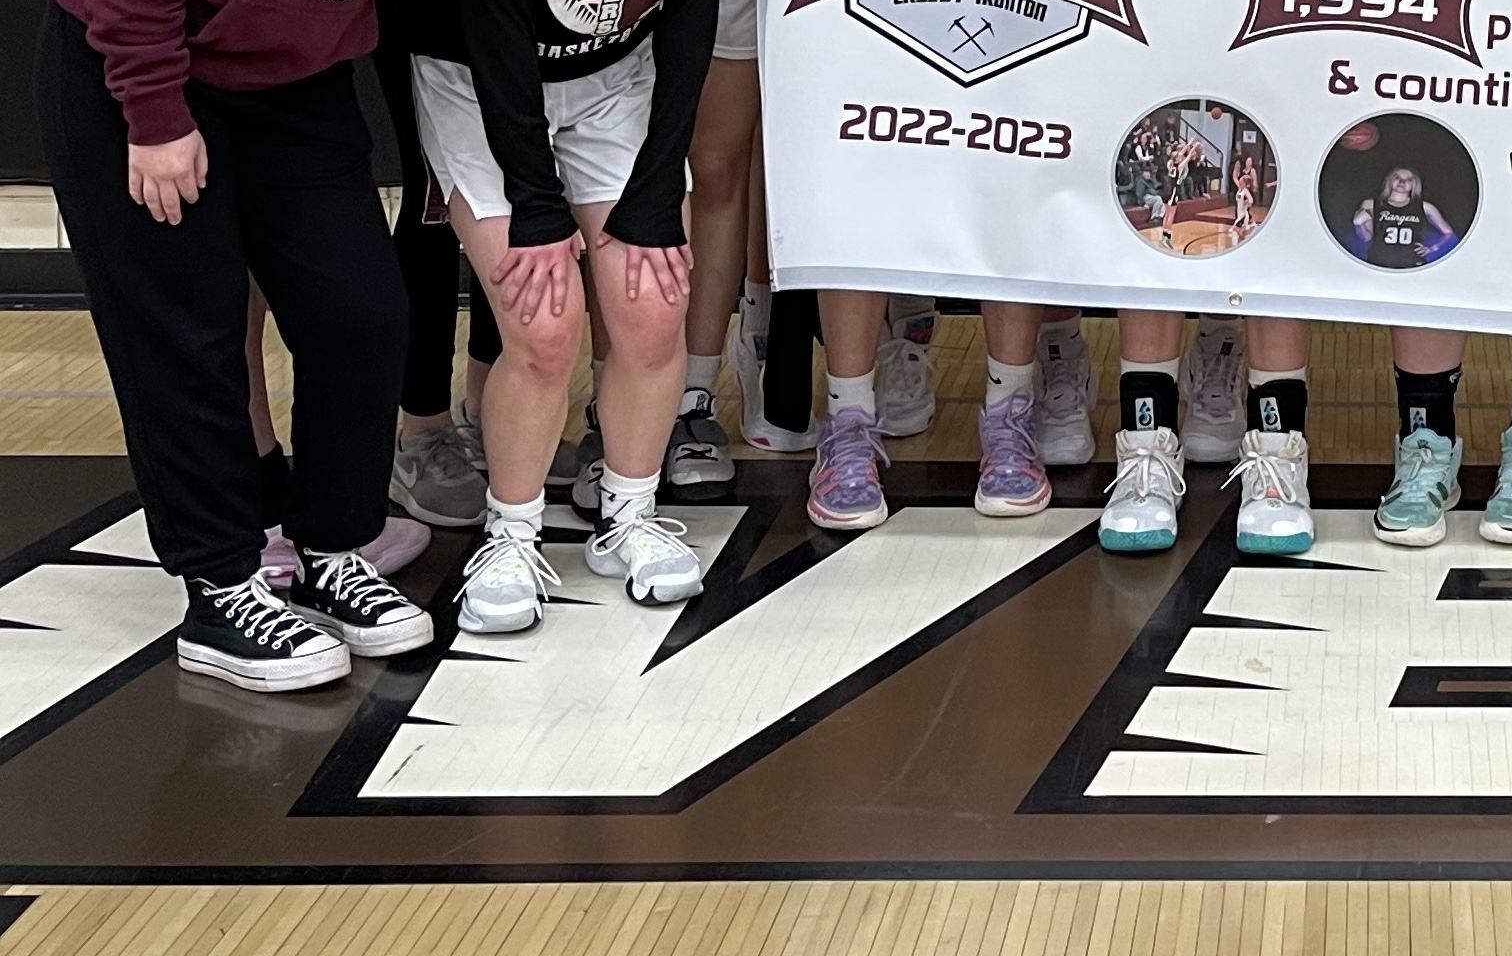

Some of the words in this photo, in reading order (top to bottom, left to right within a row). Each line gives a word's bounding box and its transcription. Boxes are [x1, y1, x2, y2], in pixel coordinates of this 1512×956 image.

[1327, 61, 1360, 96] &
[839, 104, 1072, 159] 2022-2023
[1378, 210, 1420, 226] Rangers
[1384, 226, 1413, 245] 30
